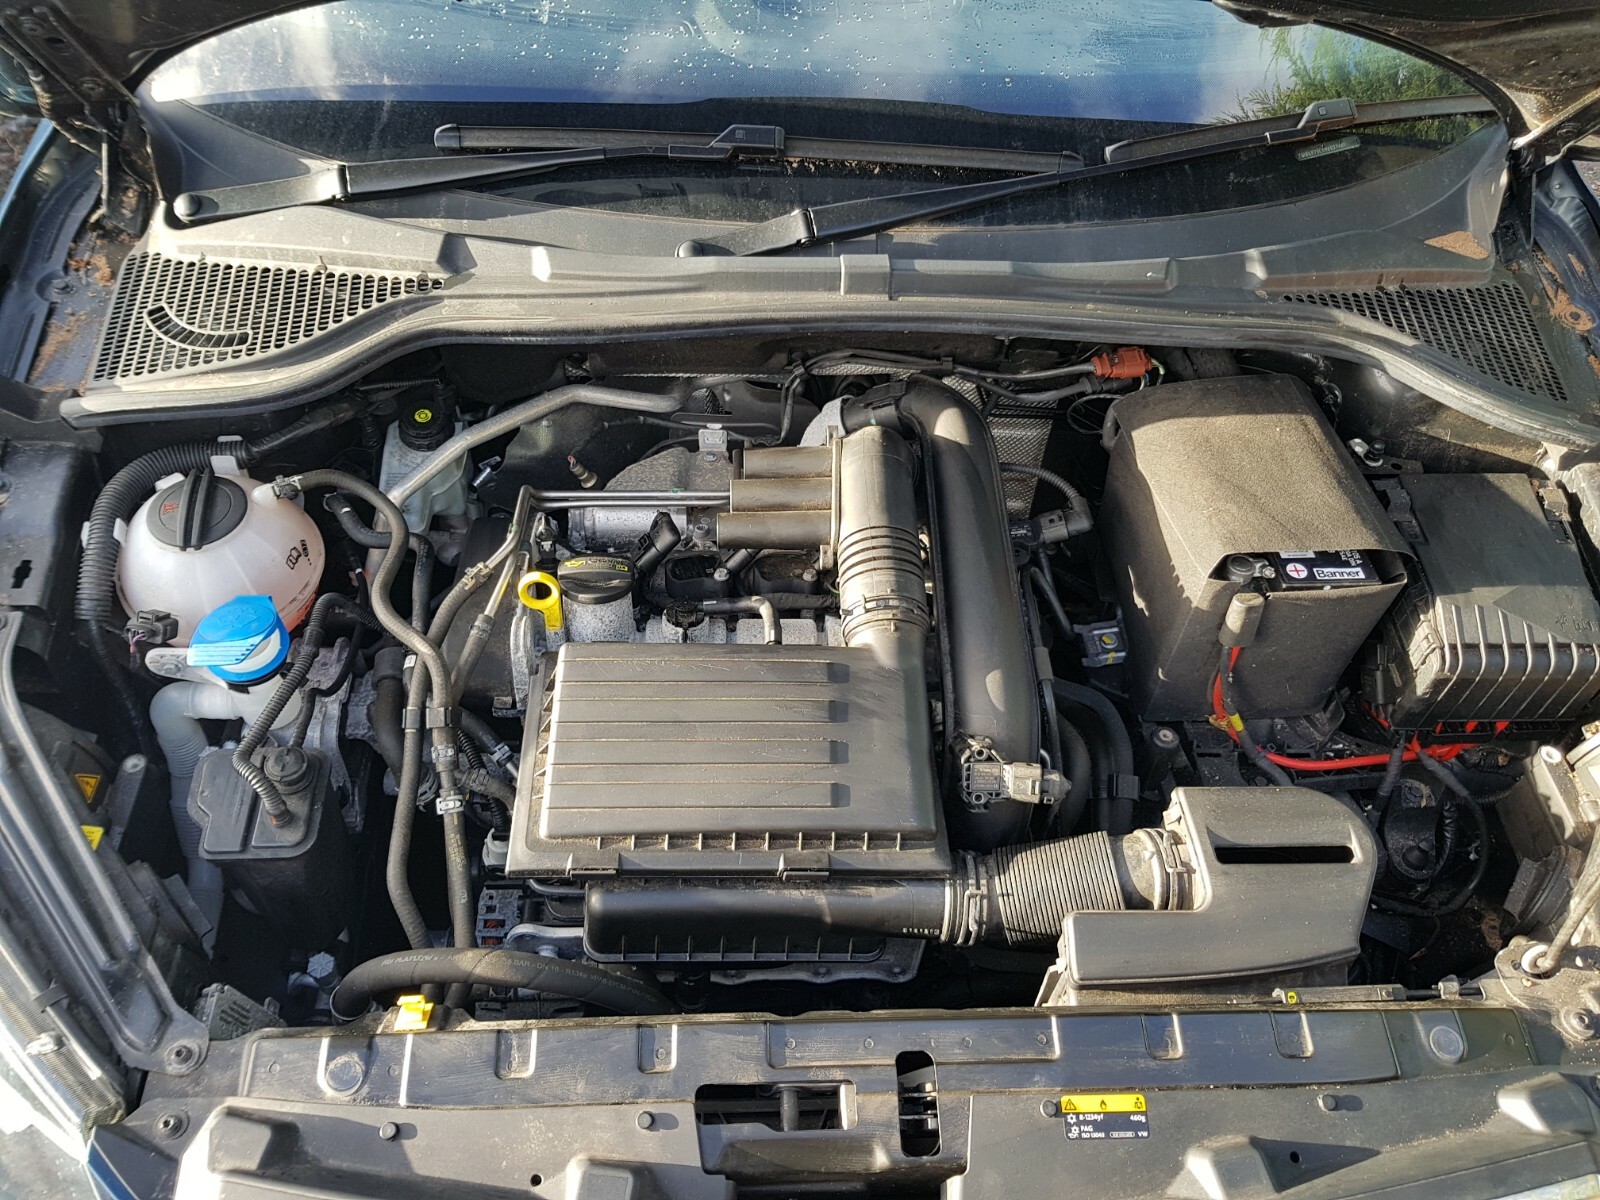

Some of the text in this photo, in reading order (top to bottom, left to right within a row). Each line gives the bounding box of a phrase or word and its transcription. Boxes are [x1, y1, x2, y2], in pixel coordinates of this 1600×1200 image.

[1315, 569, 1360, 578] Banner
[513, 958, 530, 967] BAR
[1130, 1115, 1146, 1123] 460g
